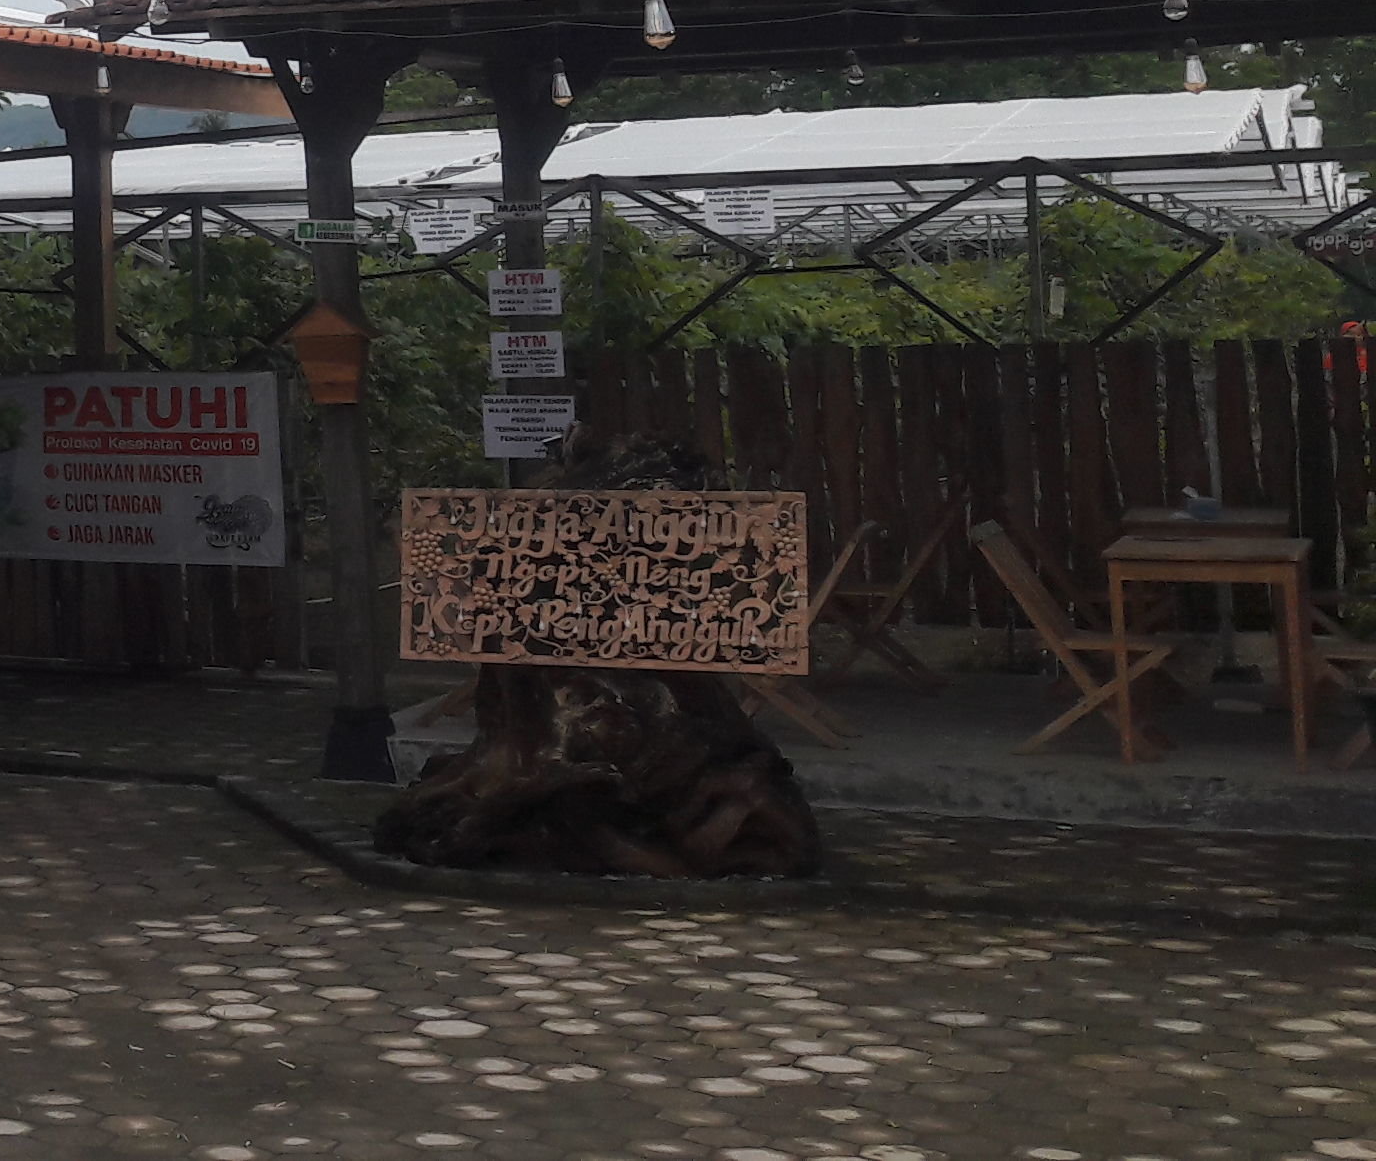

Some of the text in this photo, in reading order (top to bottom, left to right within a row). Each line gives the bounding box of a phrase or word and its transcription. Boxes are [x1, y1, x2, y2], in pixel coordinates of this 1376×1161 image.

[497, 203, 543, 213] MASUK
[505, 272, 544, 286] HTM
[508, 334, 547, 348] HTM
[44, 386, 248, 429] PATUHI
[45, 435, 257, 452] Protokol Kesehatan Covid 19
[63, 462, 204, 484] GUNAKAN MASKER
[64, 493, 163, 515] CUCI TANGAN
[67, 524, 156, 545] JAGA JARAK
[590, 497, 759, 562] Anggur
